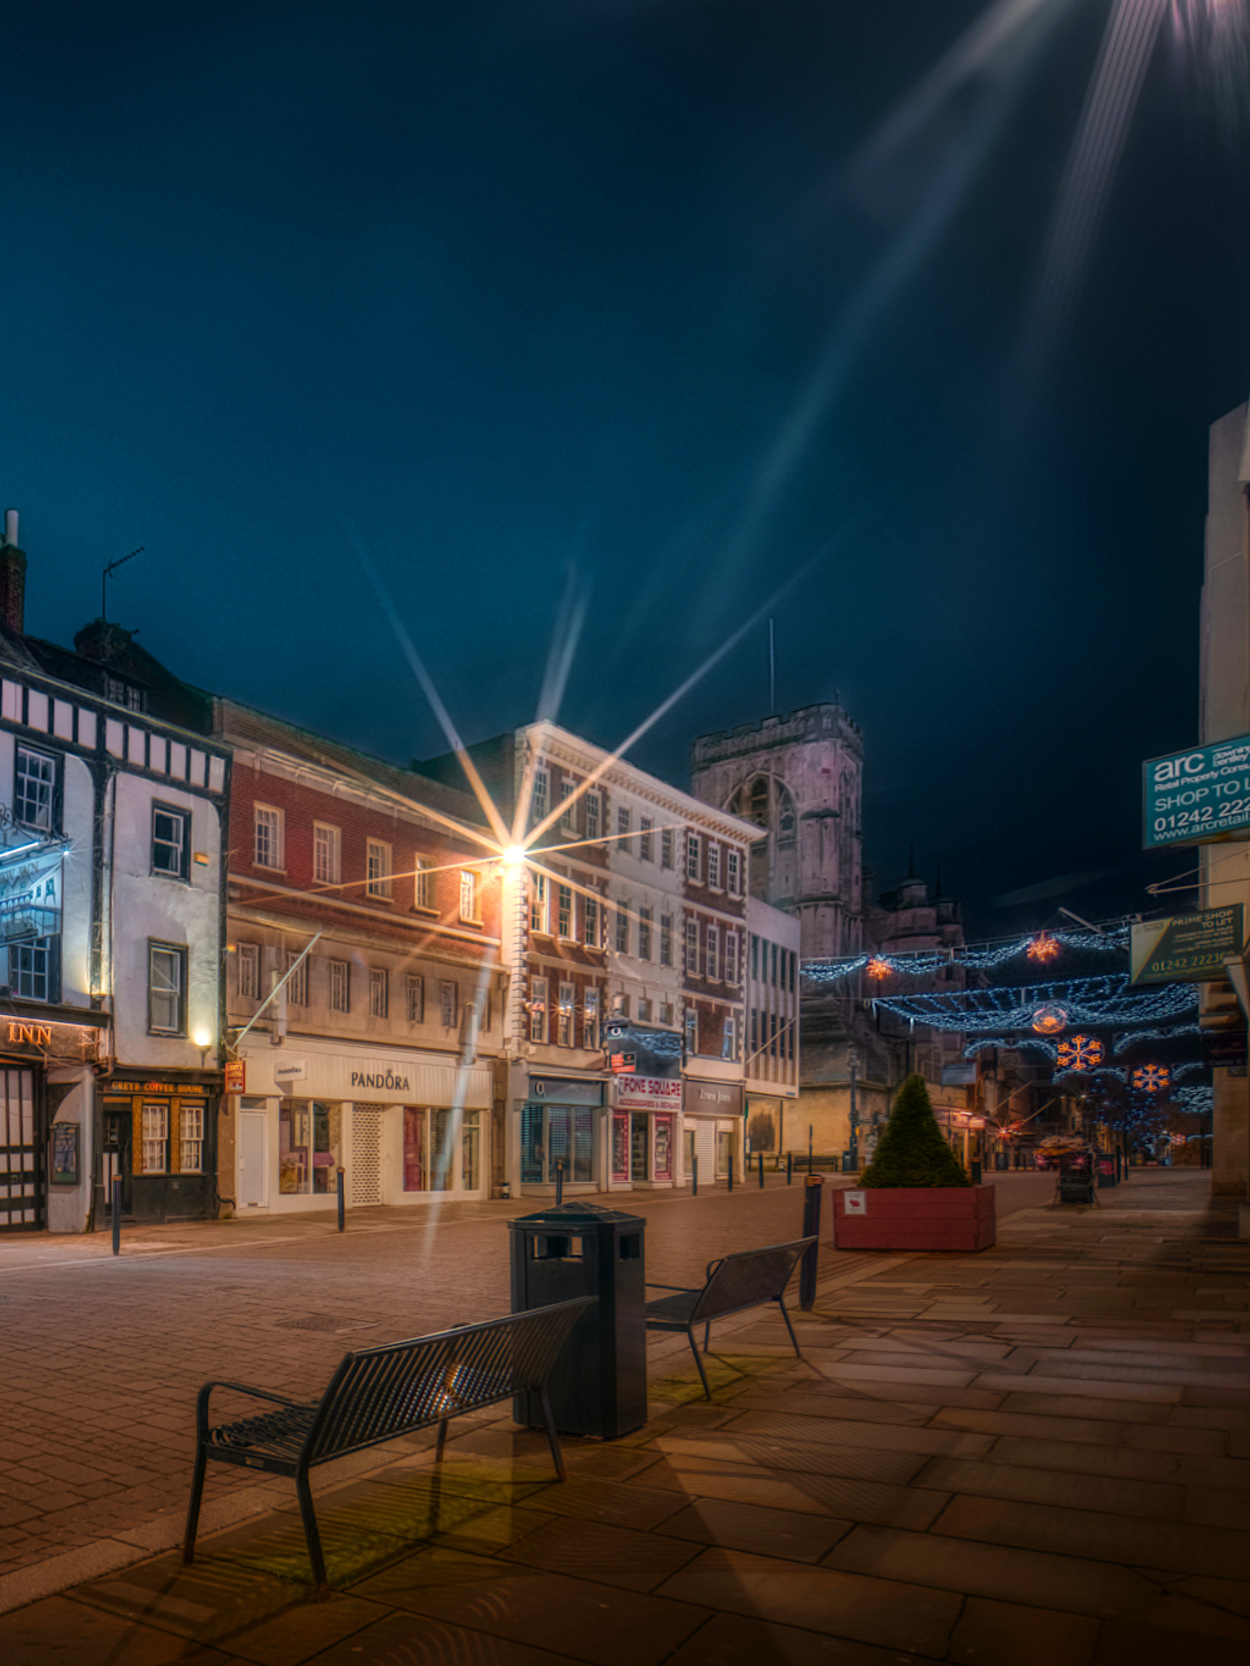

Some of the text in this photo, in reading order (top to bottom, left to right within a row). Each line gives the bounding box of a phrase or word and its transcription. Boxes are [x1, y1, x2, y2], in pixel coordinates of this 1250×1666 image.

[1154, 753, 1205, 782] arc
[1154, 779, 1179, 793] Retail
[1181, 770, 1219, 786] Property
[1154, 787, 1209, 812] SHOP
[1212, 780, 1240, 797] TO
[1154, 806, 1213, 831] 01242
[1172, 909, 1234, 927] PRIME SHOP
[1202, 916, 1234, 928] TO LET
[7, 1021, 52, 1045] INN
[351, 1069, 410, 1091] PANDORA
[624, 1077, 681, 1096] FONE SQUARE
